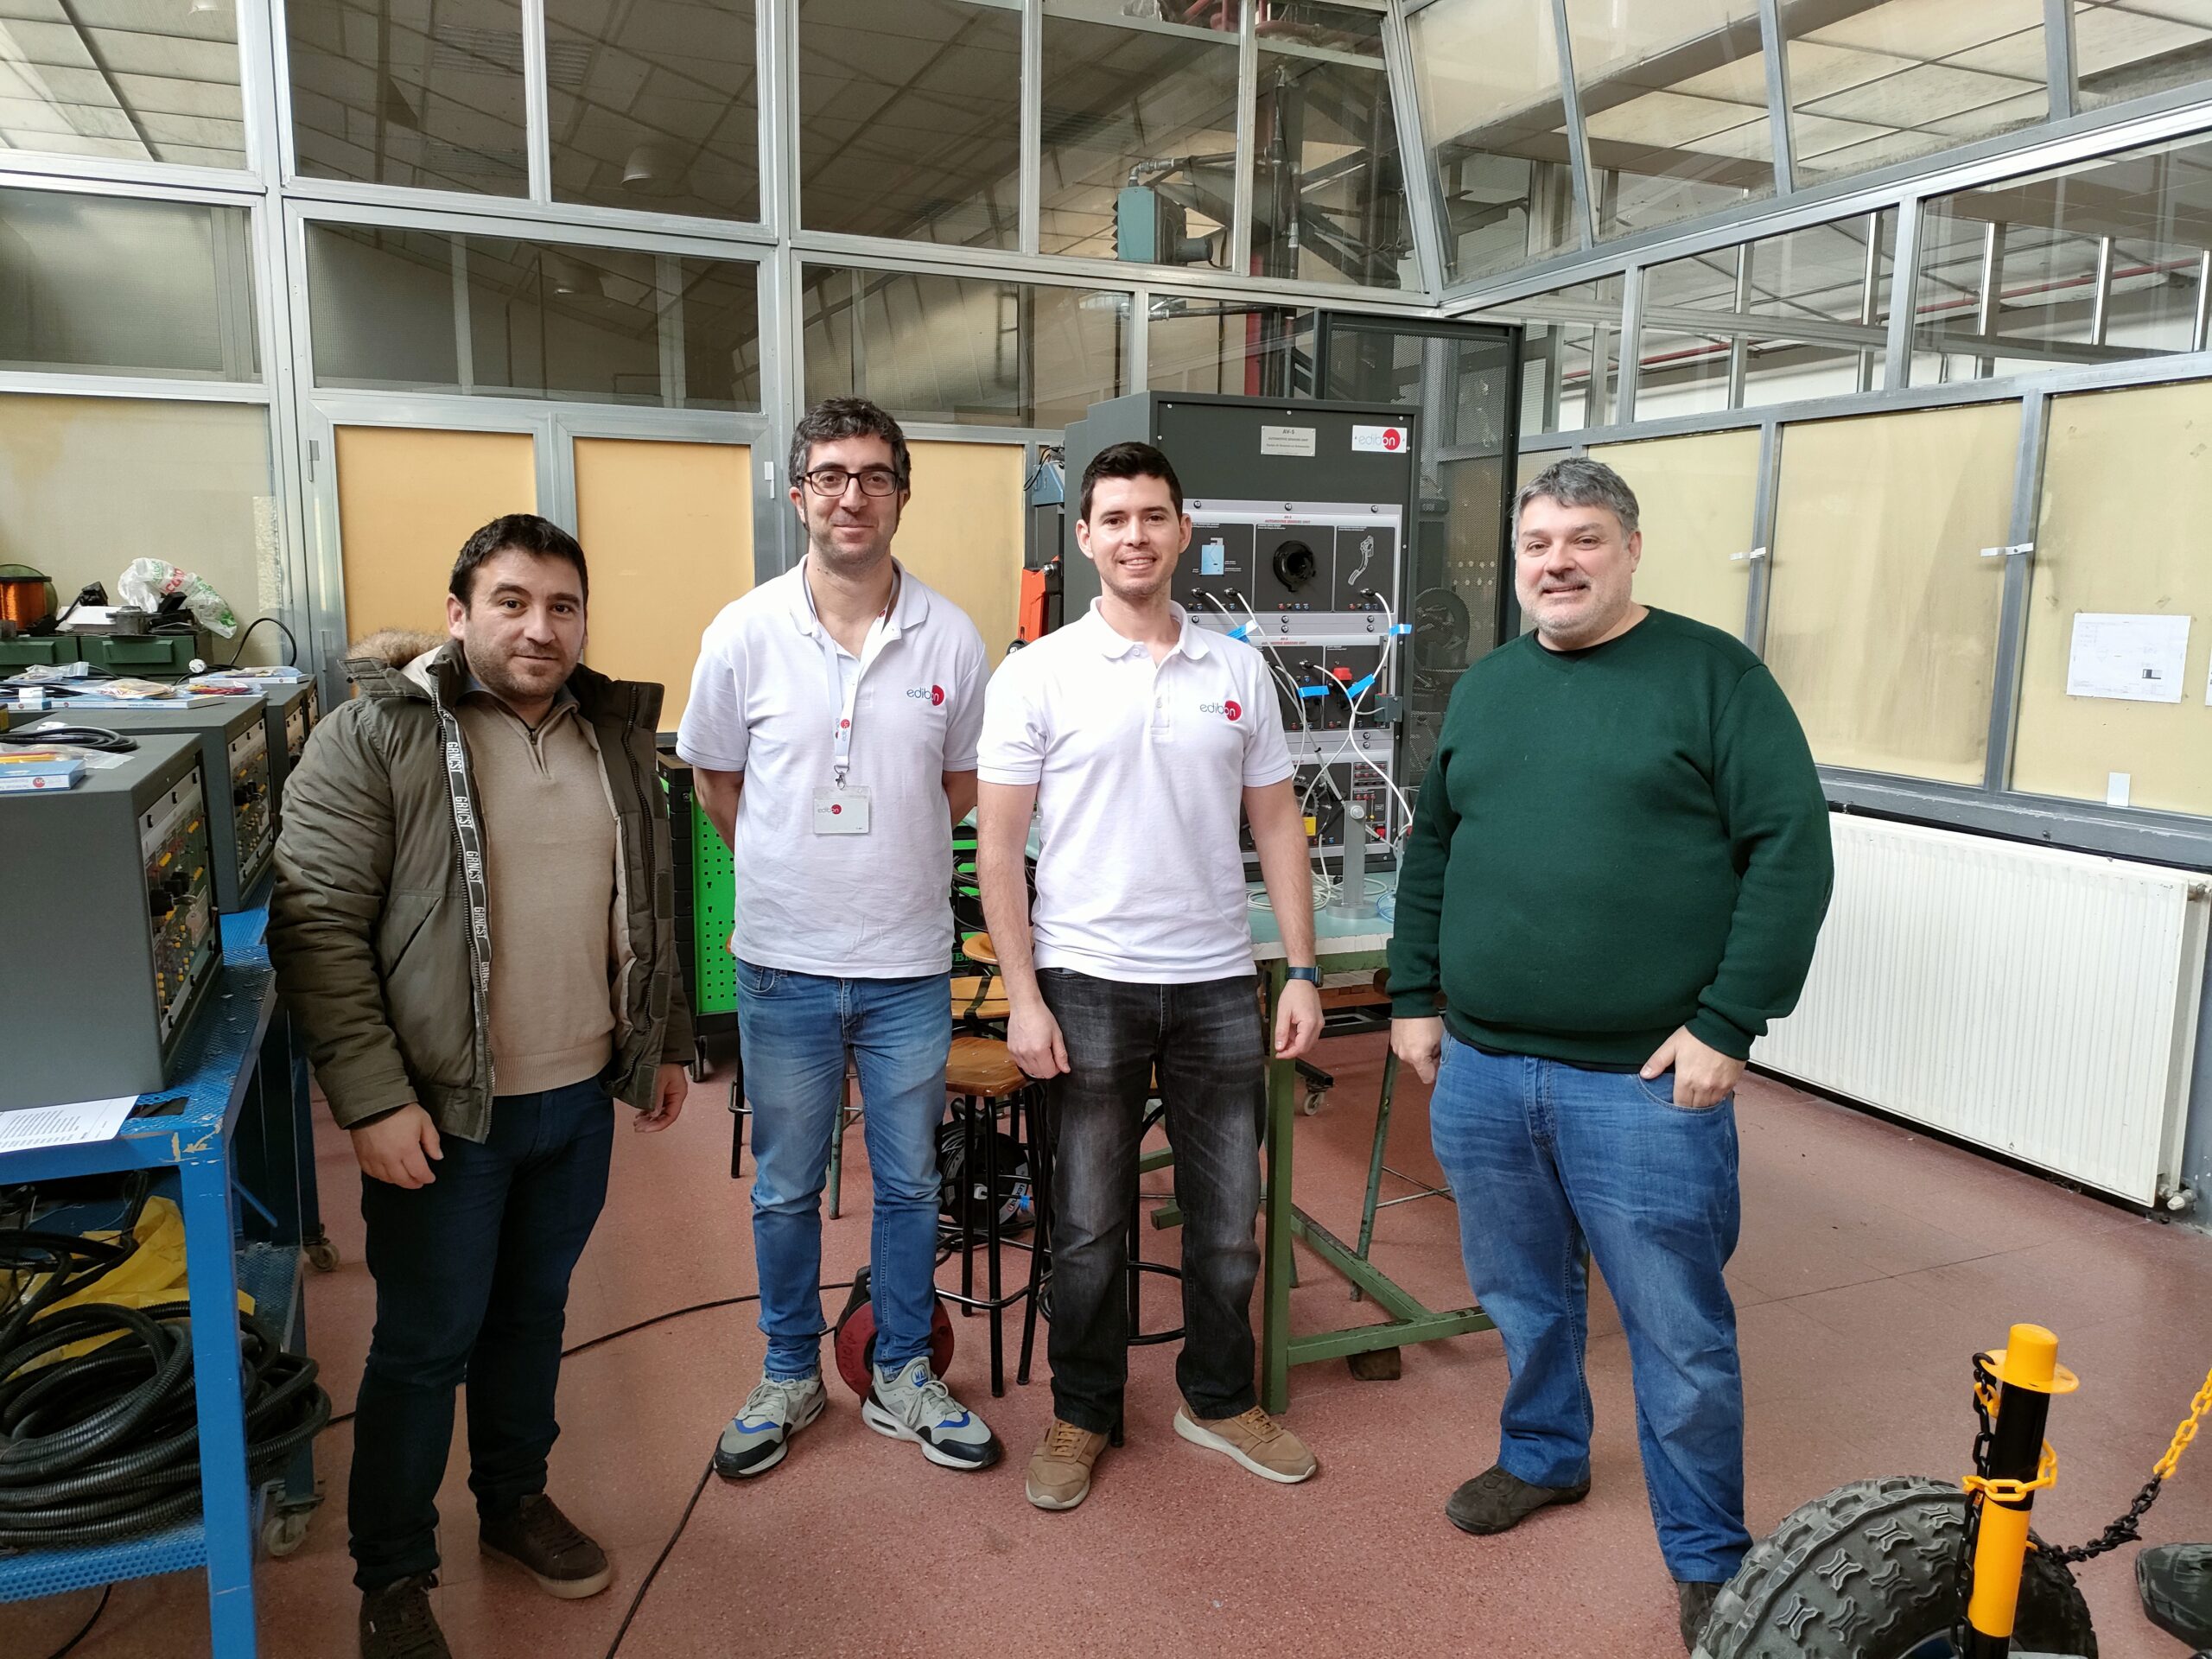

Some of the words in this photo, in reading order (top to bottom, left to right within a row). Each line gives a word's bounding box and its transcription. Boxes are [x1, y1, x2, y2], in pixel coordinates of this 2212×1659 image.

[1358, 433, 1395, 446] edibon
[1199, 702, 1236, 717] edibon
[447, 741, 463, 773] GRNCST
[454, 796, 474, 829] GRNCST
[466, 850, 481, 884] GRNCST
[474, 906, 486, 939] GRNCST
